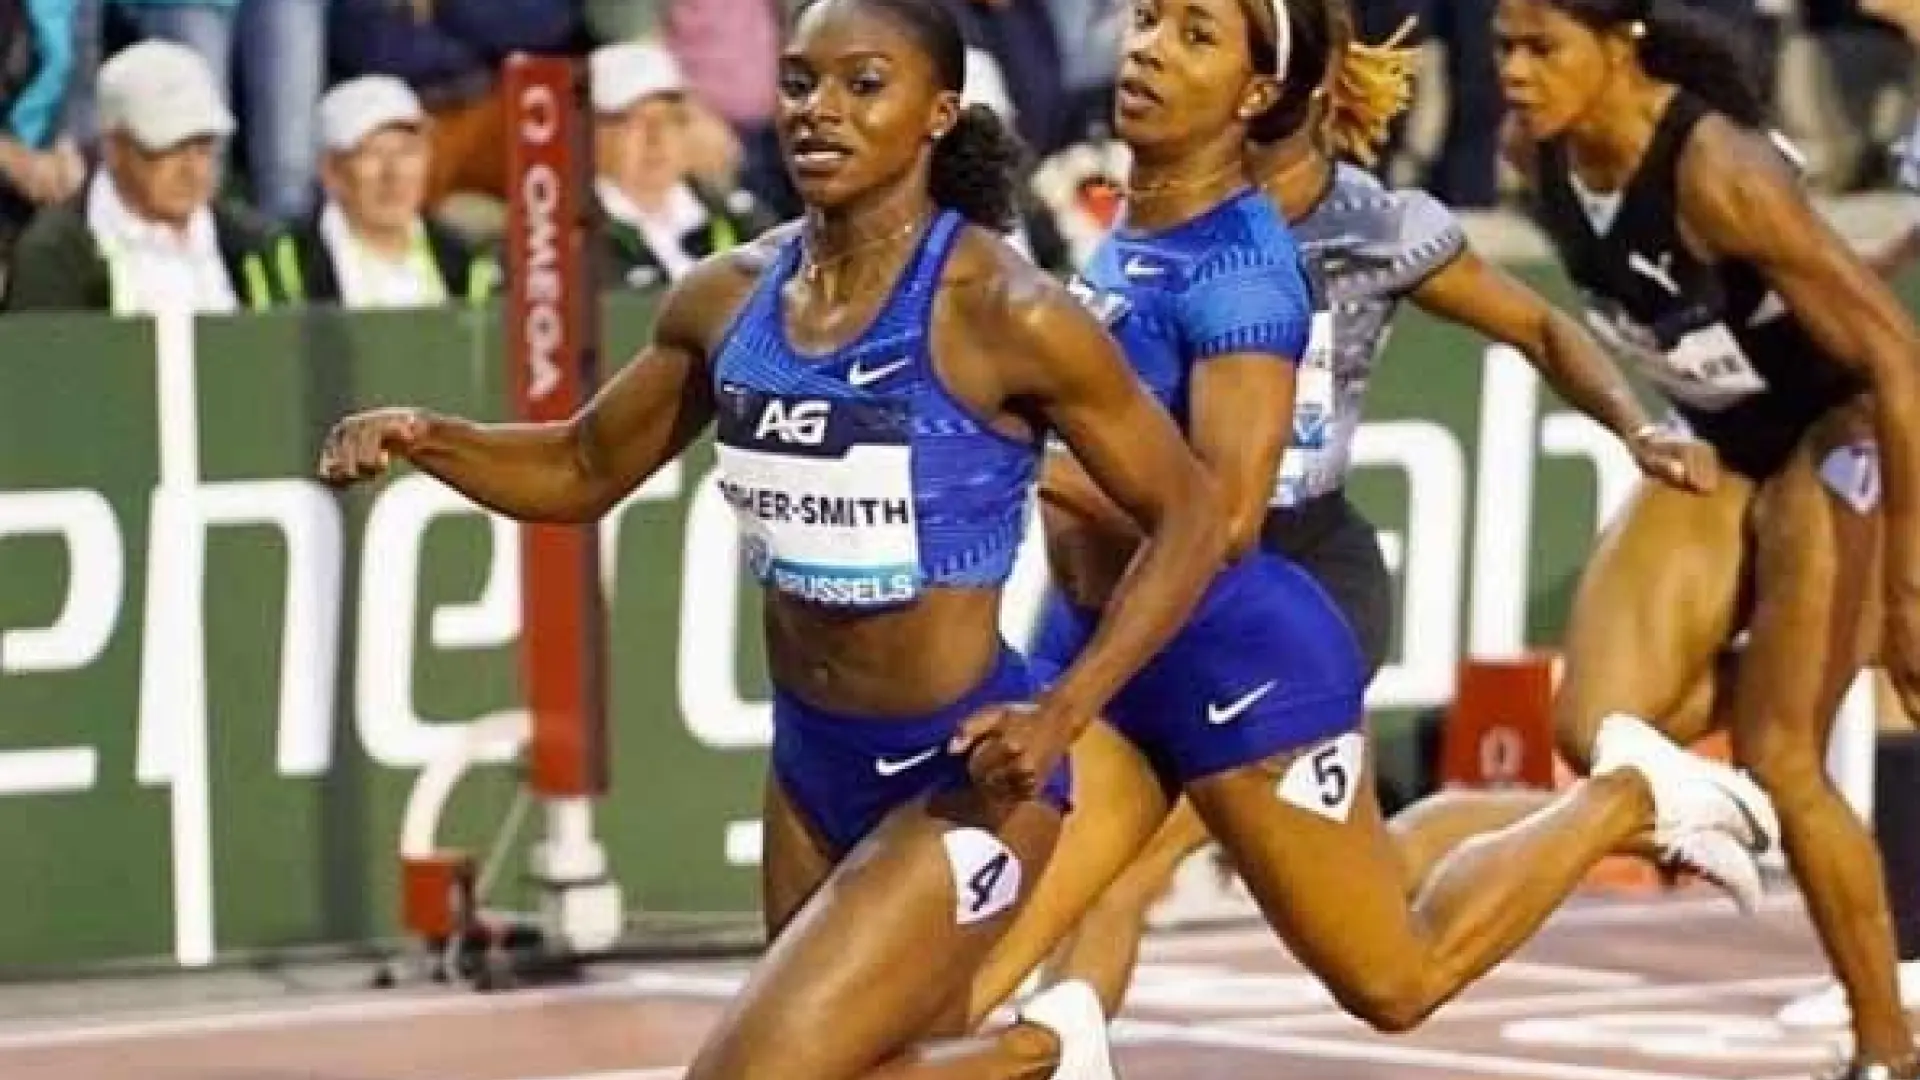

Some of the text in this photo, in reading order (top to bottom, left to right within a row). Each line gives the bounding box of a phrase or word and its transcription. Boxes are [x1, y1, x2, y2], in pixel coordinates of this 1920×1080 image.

[521, 164, 564, 400] OMEGA
[754, 399, 831, 445] AG
[1312, 745, 1346, 808] 5
[968, 852, 1010, 912] 4
